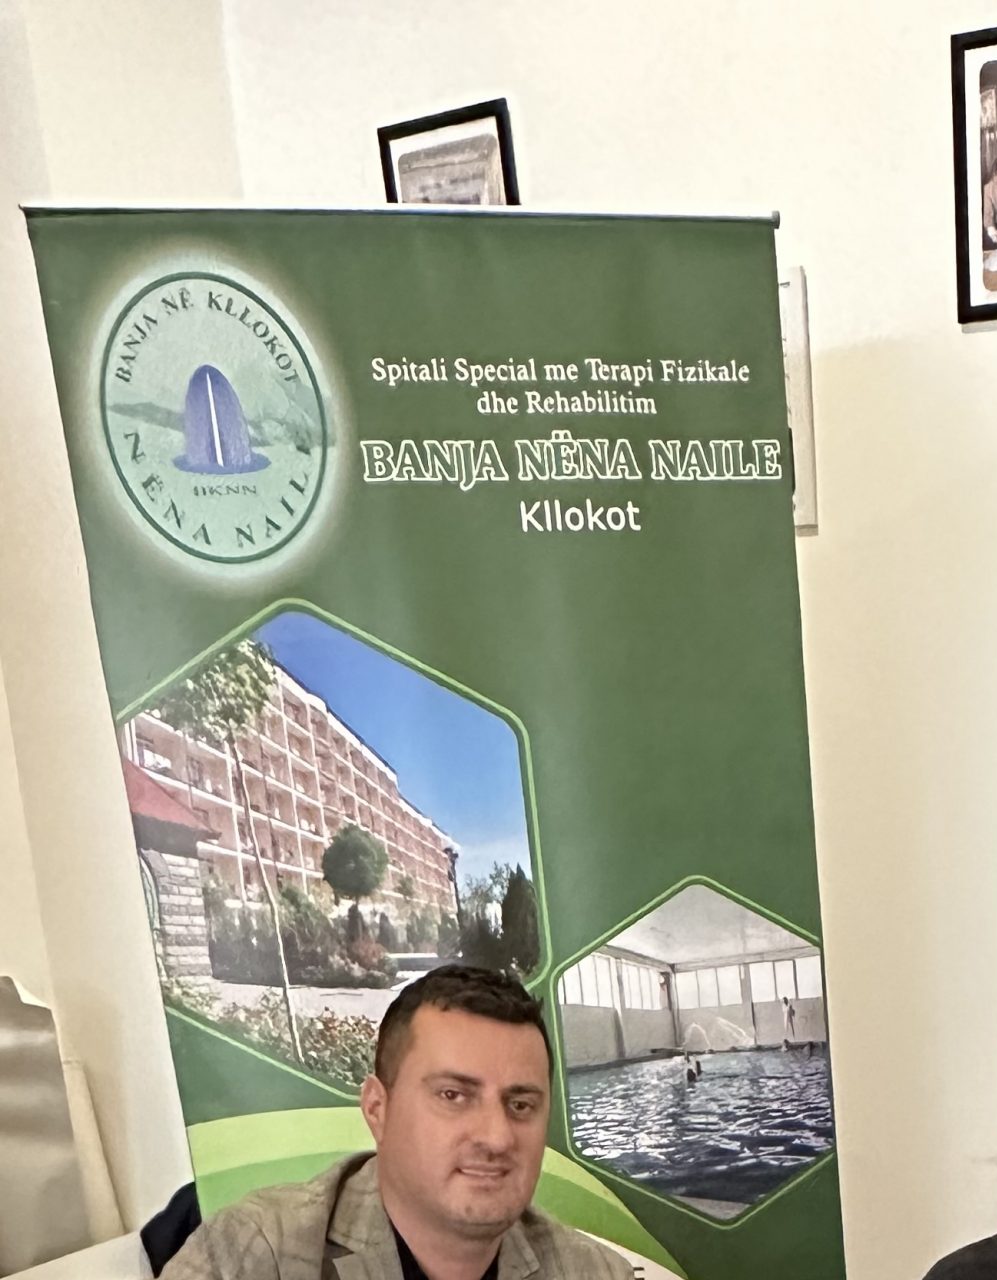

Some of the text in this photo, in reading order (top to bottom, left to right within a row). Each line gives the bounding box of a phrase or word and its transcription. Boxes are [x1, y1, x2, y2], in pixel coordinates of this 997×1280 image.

[371, 358, 751, 387] Spitali Special me Terapi Fizikale
[477, 390, 657, 415] dhe Rehabilitim
[360, 429, 783, 491] BANJA NËNA NAILE
[519, 498, 642, 533] Kllokot
